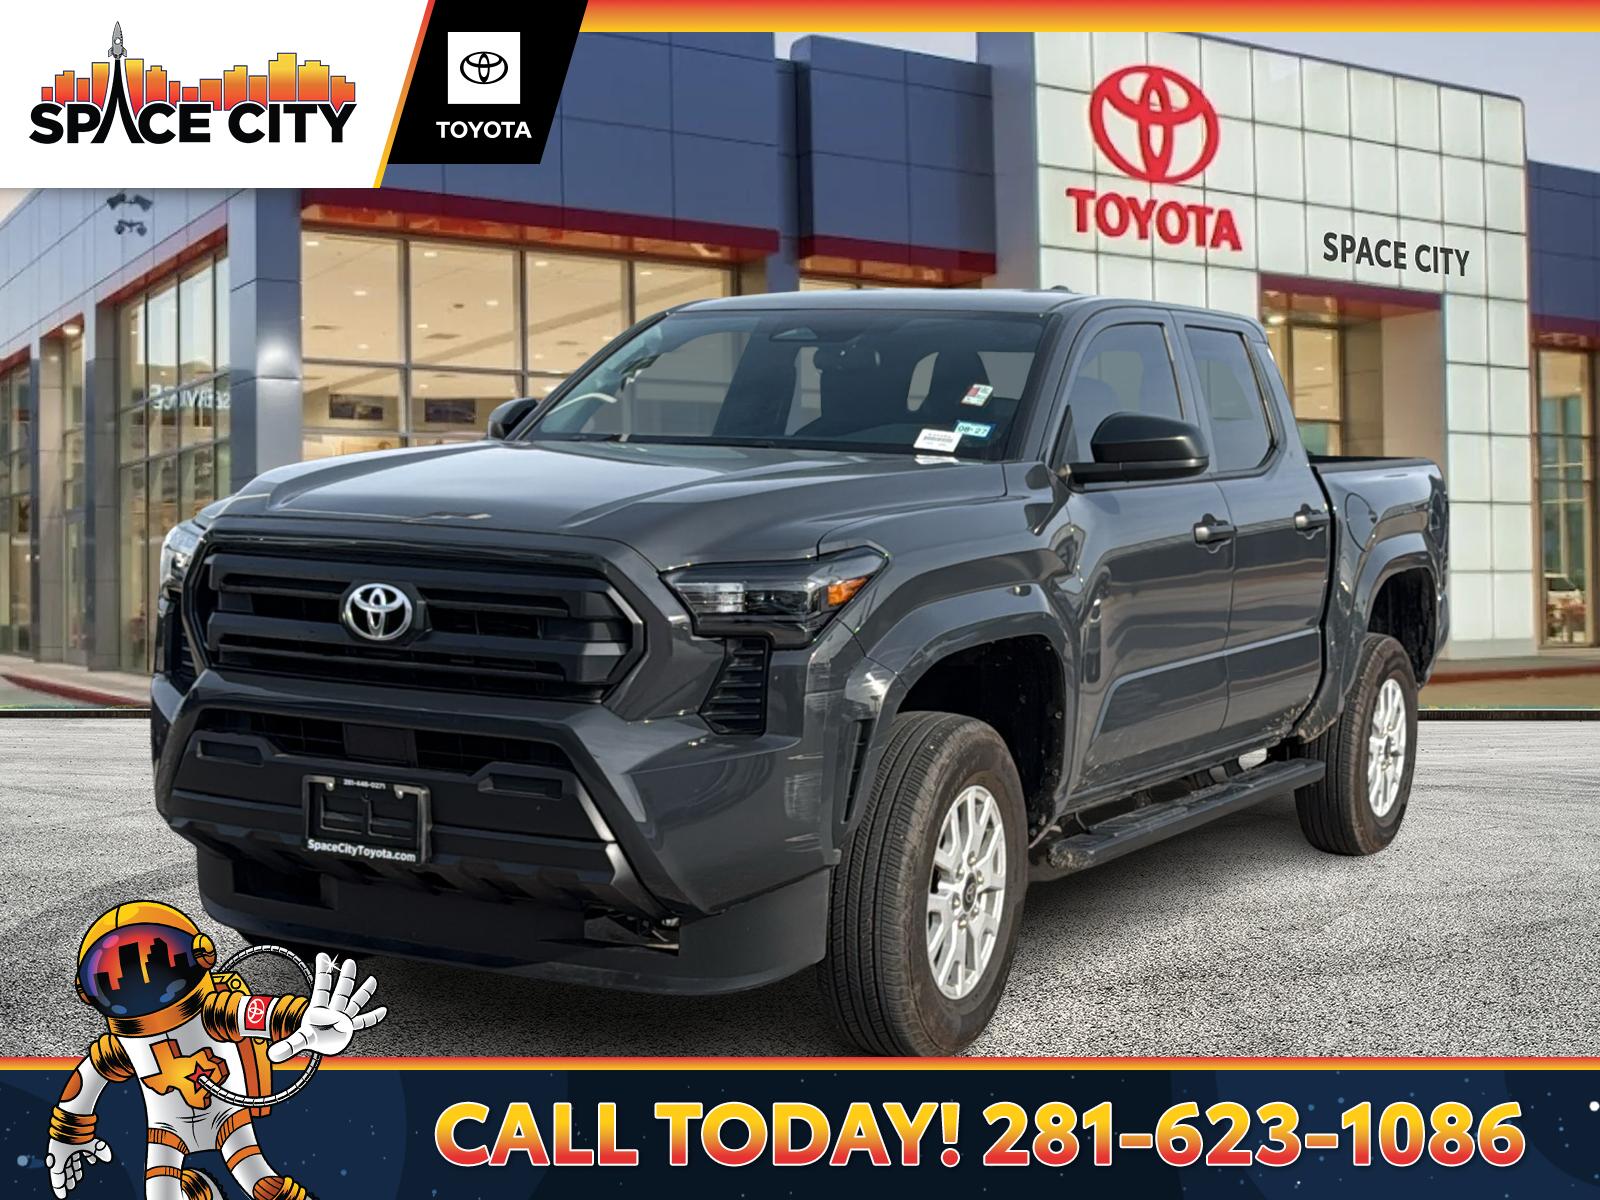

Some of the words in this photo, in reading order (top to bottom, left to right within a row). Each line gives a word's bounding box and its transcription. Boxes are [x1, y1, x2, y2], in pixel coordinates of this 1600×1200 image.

[1066, 187, 1242, 251] TOYOTA
[1323, 231, 1407, 270] SPACE
[1414, 244, 1470, 277] CITY
[307, 839, 416, 862] SpaceCityToyota.com
